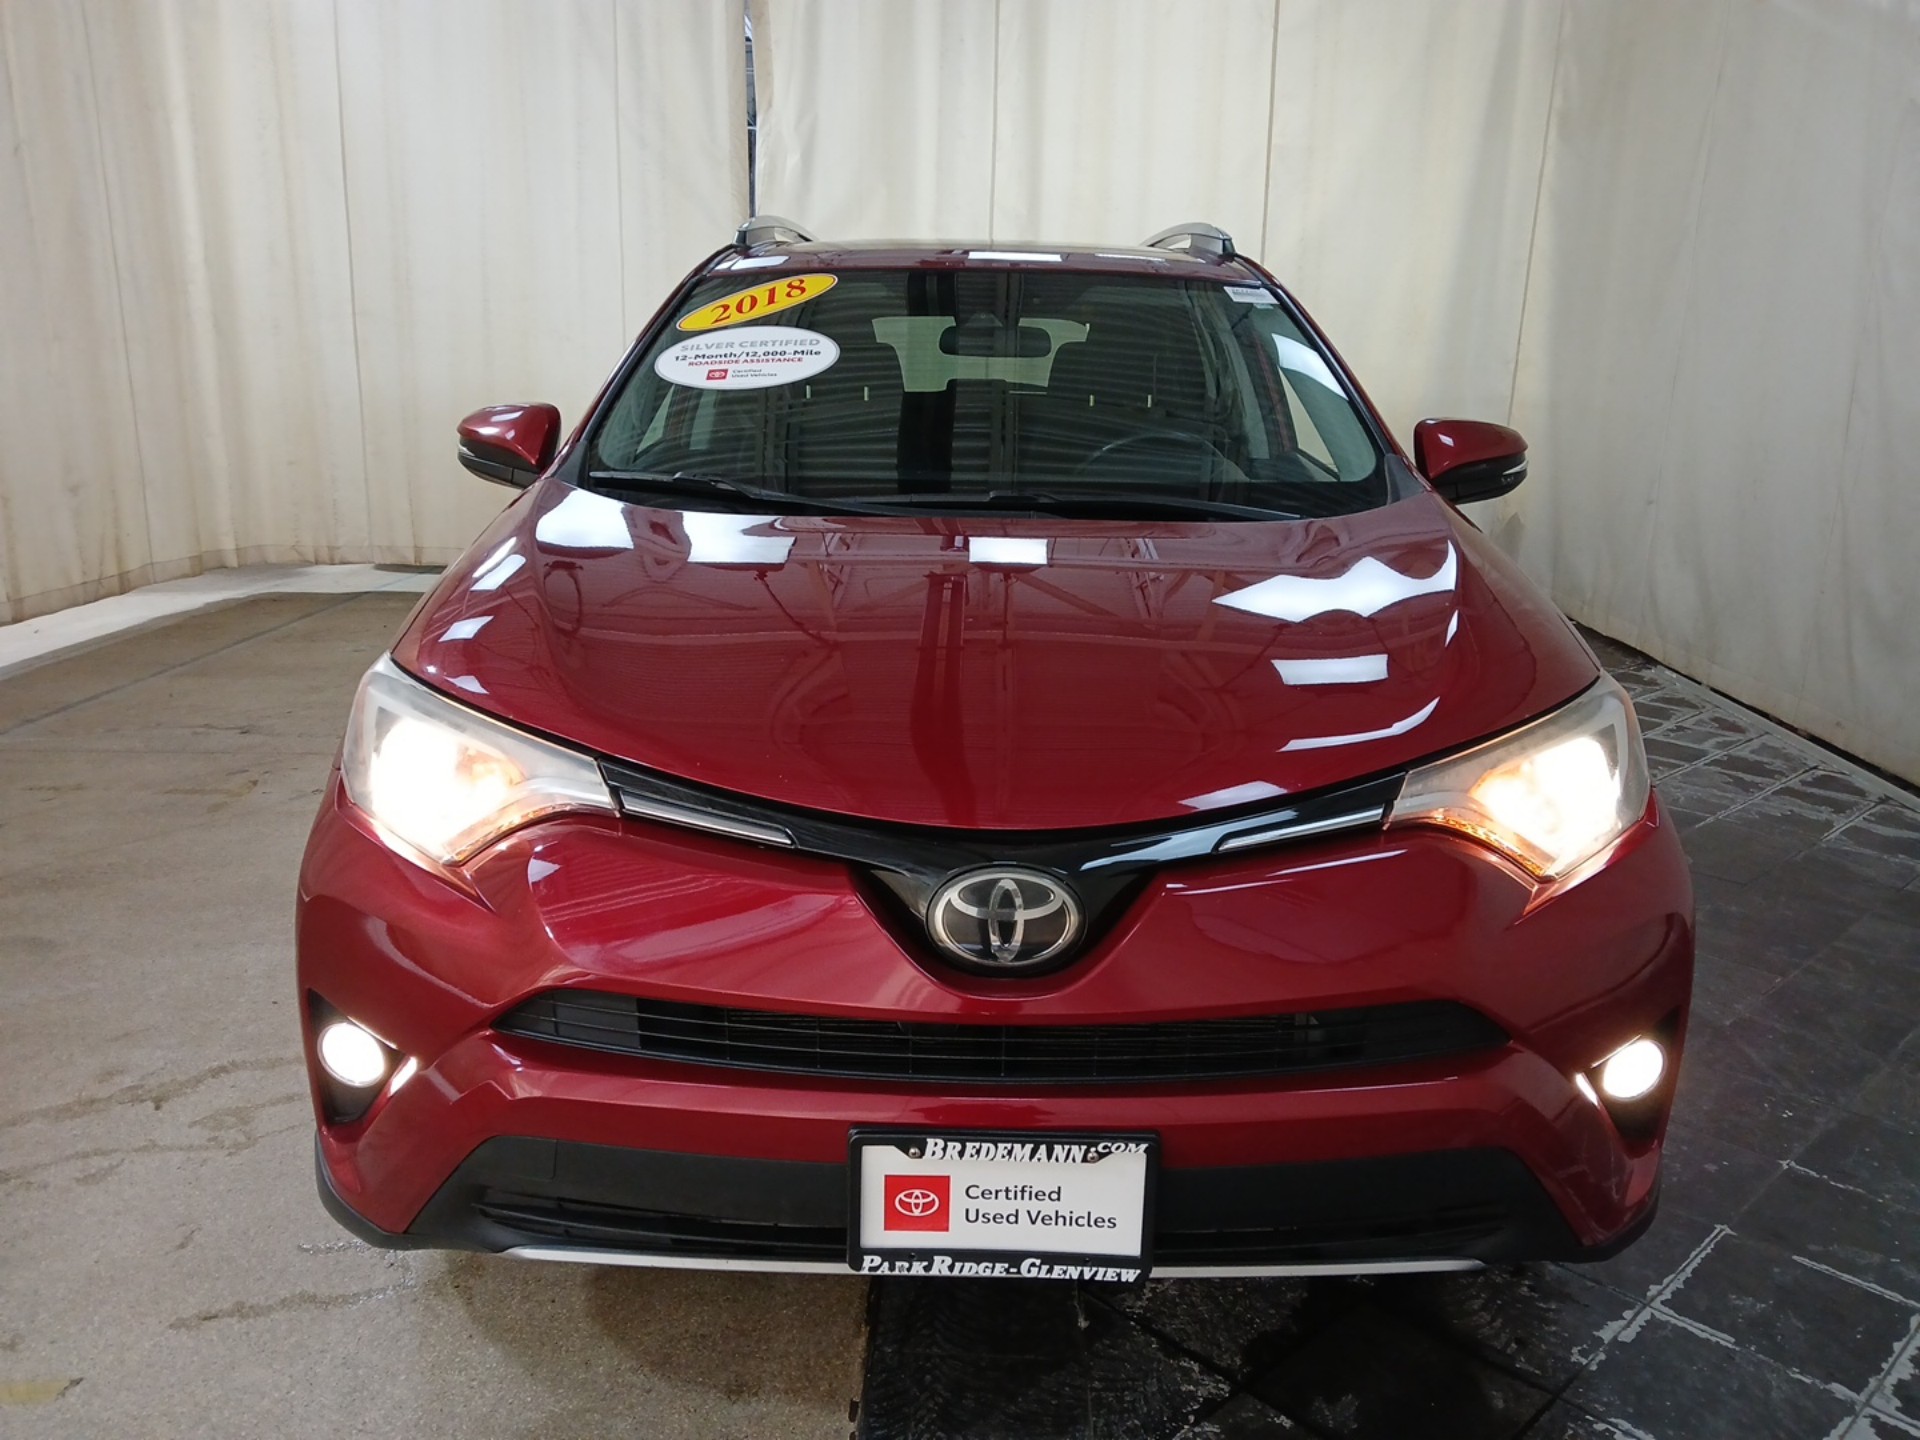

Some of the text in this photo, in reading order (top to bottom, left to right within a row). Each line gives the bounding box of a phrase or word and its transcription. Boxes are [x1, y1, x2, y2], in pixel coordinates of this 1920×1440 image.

[710, 278, 808, 325] 2018
[680, 338, 821, 352] SILVER CERTIFIED
[674, 350, 822, 362] 12-Month/12,000-Mile
[688, 357, 803, 367] ROADSIDE ASSISTANCE
[964, 1184, 1062, 1202] Certified
[964, 1207, 1117, 1229] Used Vehicles
[860, 1255, 1142, 1283] PARK RIDGE-GLENVIEW
